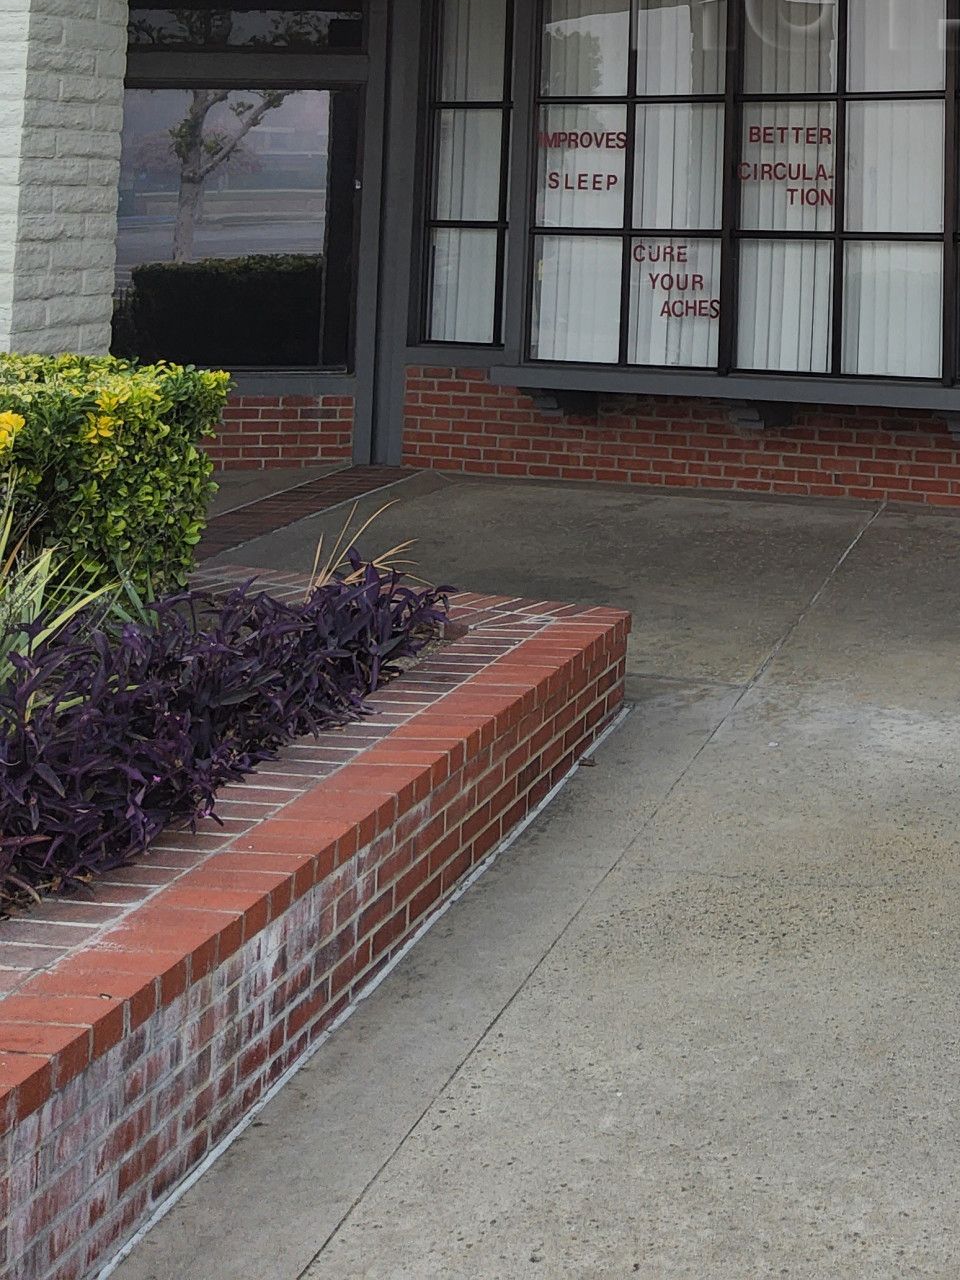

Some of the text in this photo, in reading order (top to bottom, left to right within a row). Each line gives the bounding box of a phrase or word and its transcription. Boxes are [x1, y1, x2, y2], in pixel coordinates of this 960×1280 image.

[537, 131, 627, 150] IMPROVES
[749, 126, 832, 145] BETTER
[548, 172, 618, 191] SLEEP
[786, 188, 834, 206] TION
[633, 244, 689, 263] CURE
[648, 272, 705, 291] YOUR
[660, 299, 721, 319] ACHES
